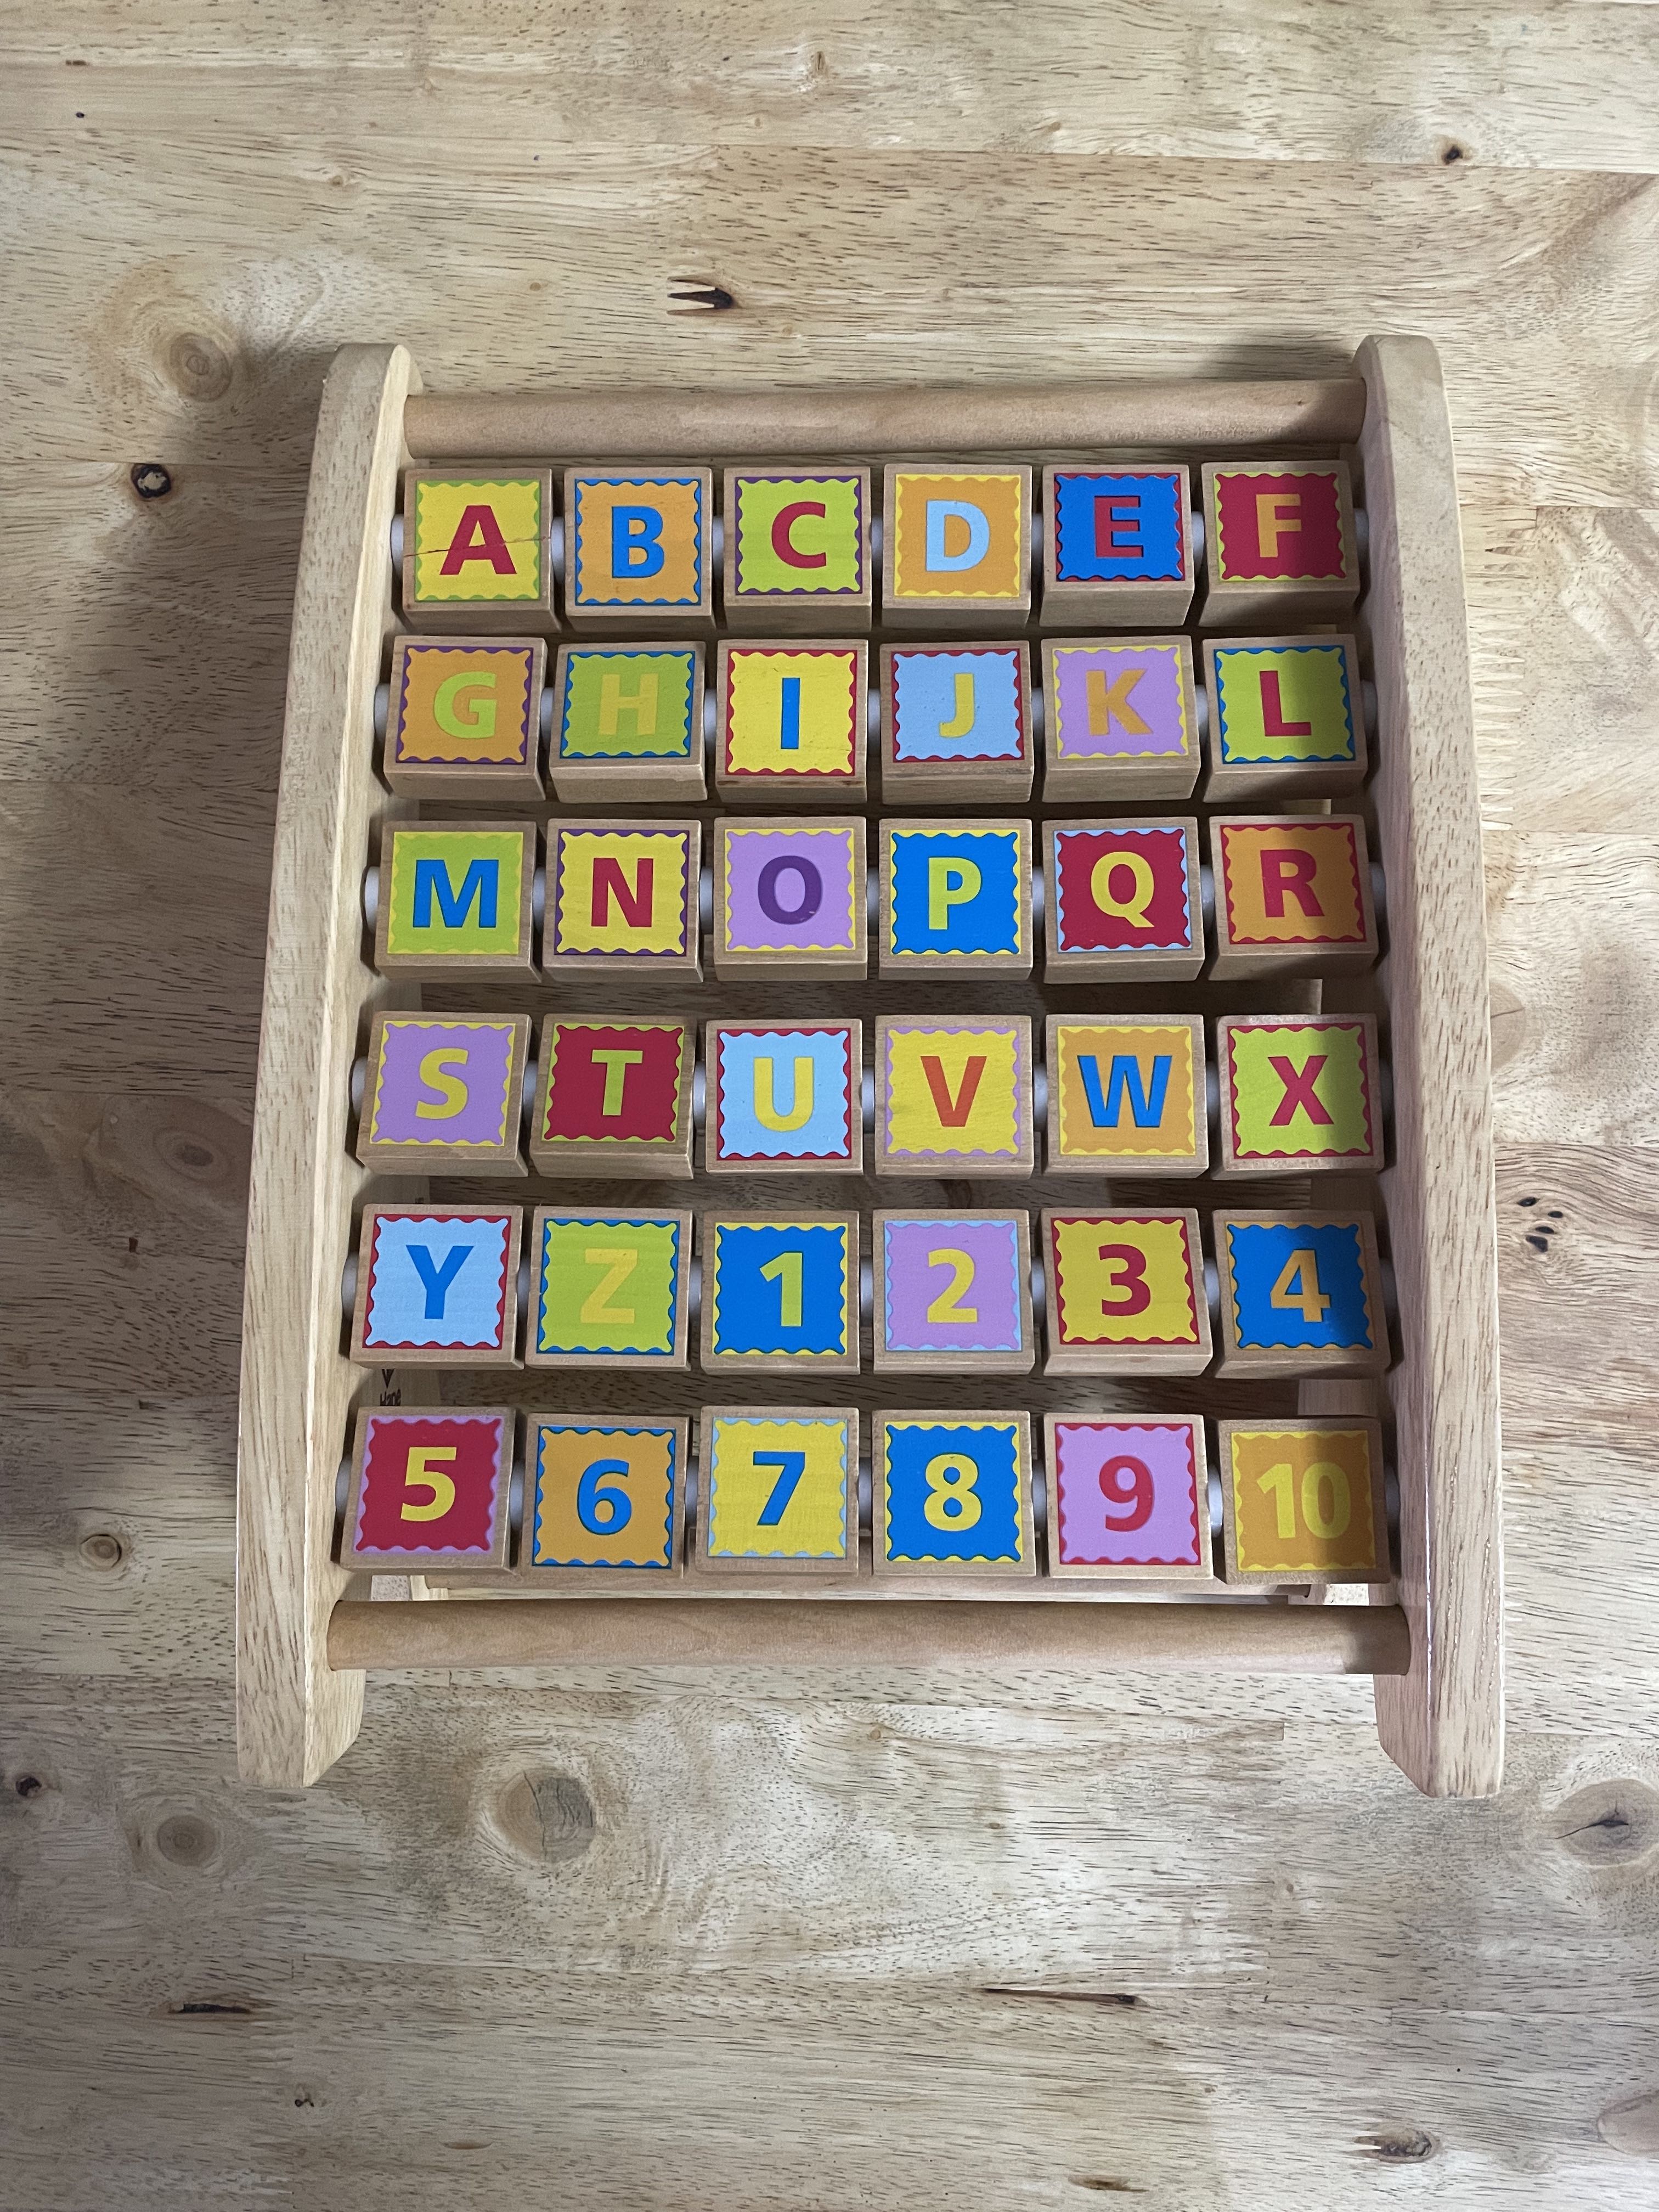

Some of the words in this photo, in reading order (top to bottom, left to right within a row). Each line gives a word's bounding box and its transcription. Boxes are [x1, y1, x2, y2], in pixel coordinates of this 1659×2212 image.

[439, 505, 517, 575] A
[611, 505, 665, 579] B
[771, 501, 827, 570] C
[925, 499, 990, 572] D
[1093, 495, 1144, 558] E
[1256, 493, 1302, 558] F
[432, 671, 498, 740] G
[598, 672, 659, 736] H
[780, 677, 801, 750] I
[939, 672, 975, 739] J
[1085, 668, 1154, 737] K
[1259, 670, 1312, 738] L
[412, 859, 500, 928] M
[590, 857, 654, 928] N
[757, 855, 823, 925] O
[928, 857, 983, 931] P
[1090, 851, 1155, 928] Q
[1259, 848, 1325, 919] R
[415, 1047, 470, 1121] S
[591, 1049, 644, 1117] T
[753, 1056, 815, 1133] U
[920, 1055, 988, 1128] V
[1076, 1054, 1173, 1128] W
[1267, 1055, 1335, 1127] X
[405, 1244, 475, 1321] Y
[579, 1248, 639, 1324] Z
[758, 1251, 804, 1327] 1
[926, 1248, 979, 1324] 2
[1098, 1243, 1152, 1317] 3
[1269, 1249, 1331, 1323] 4
[399, 1446, 458, 1523] 5
[576, 1459, 633, 1536] 6
[752, 1450, 806, 1527] 7
[923, 1454, 982, 1532] 8
[1098, 1455, 1155, 1532] 9
[1256, 1461, 1351, 1540] 10
